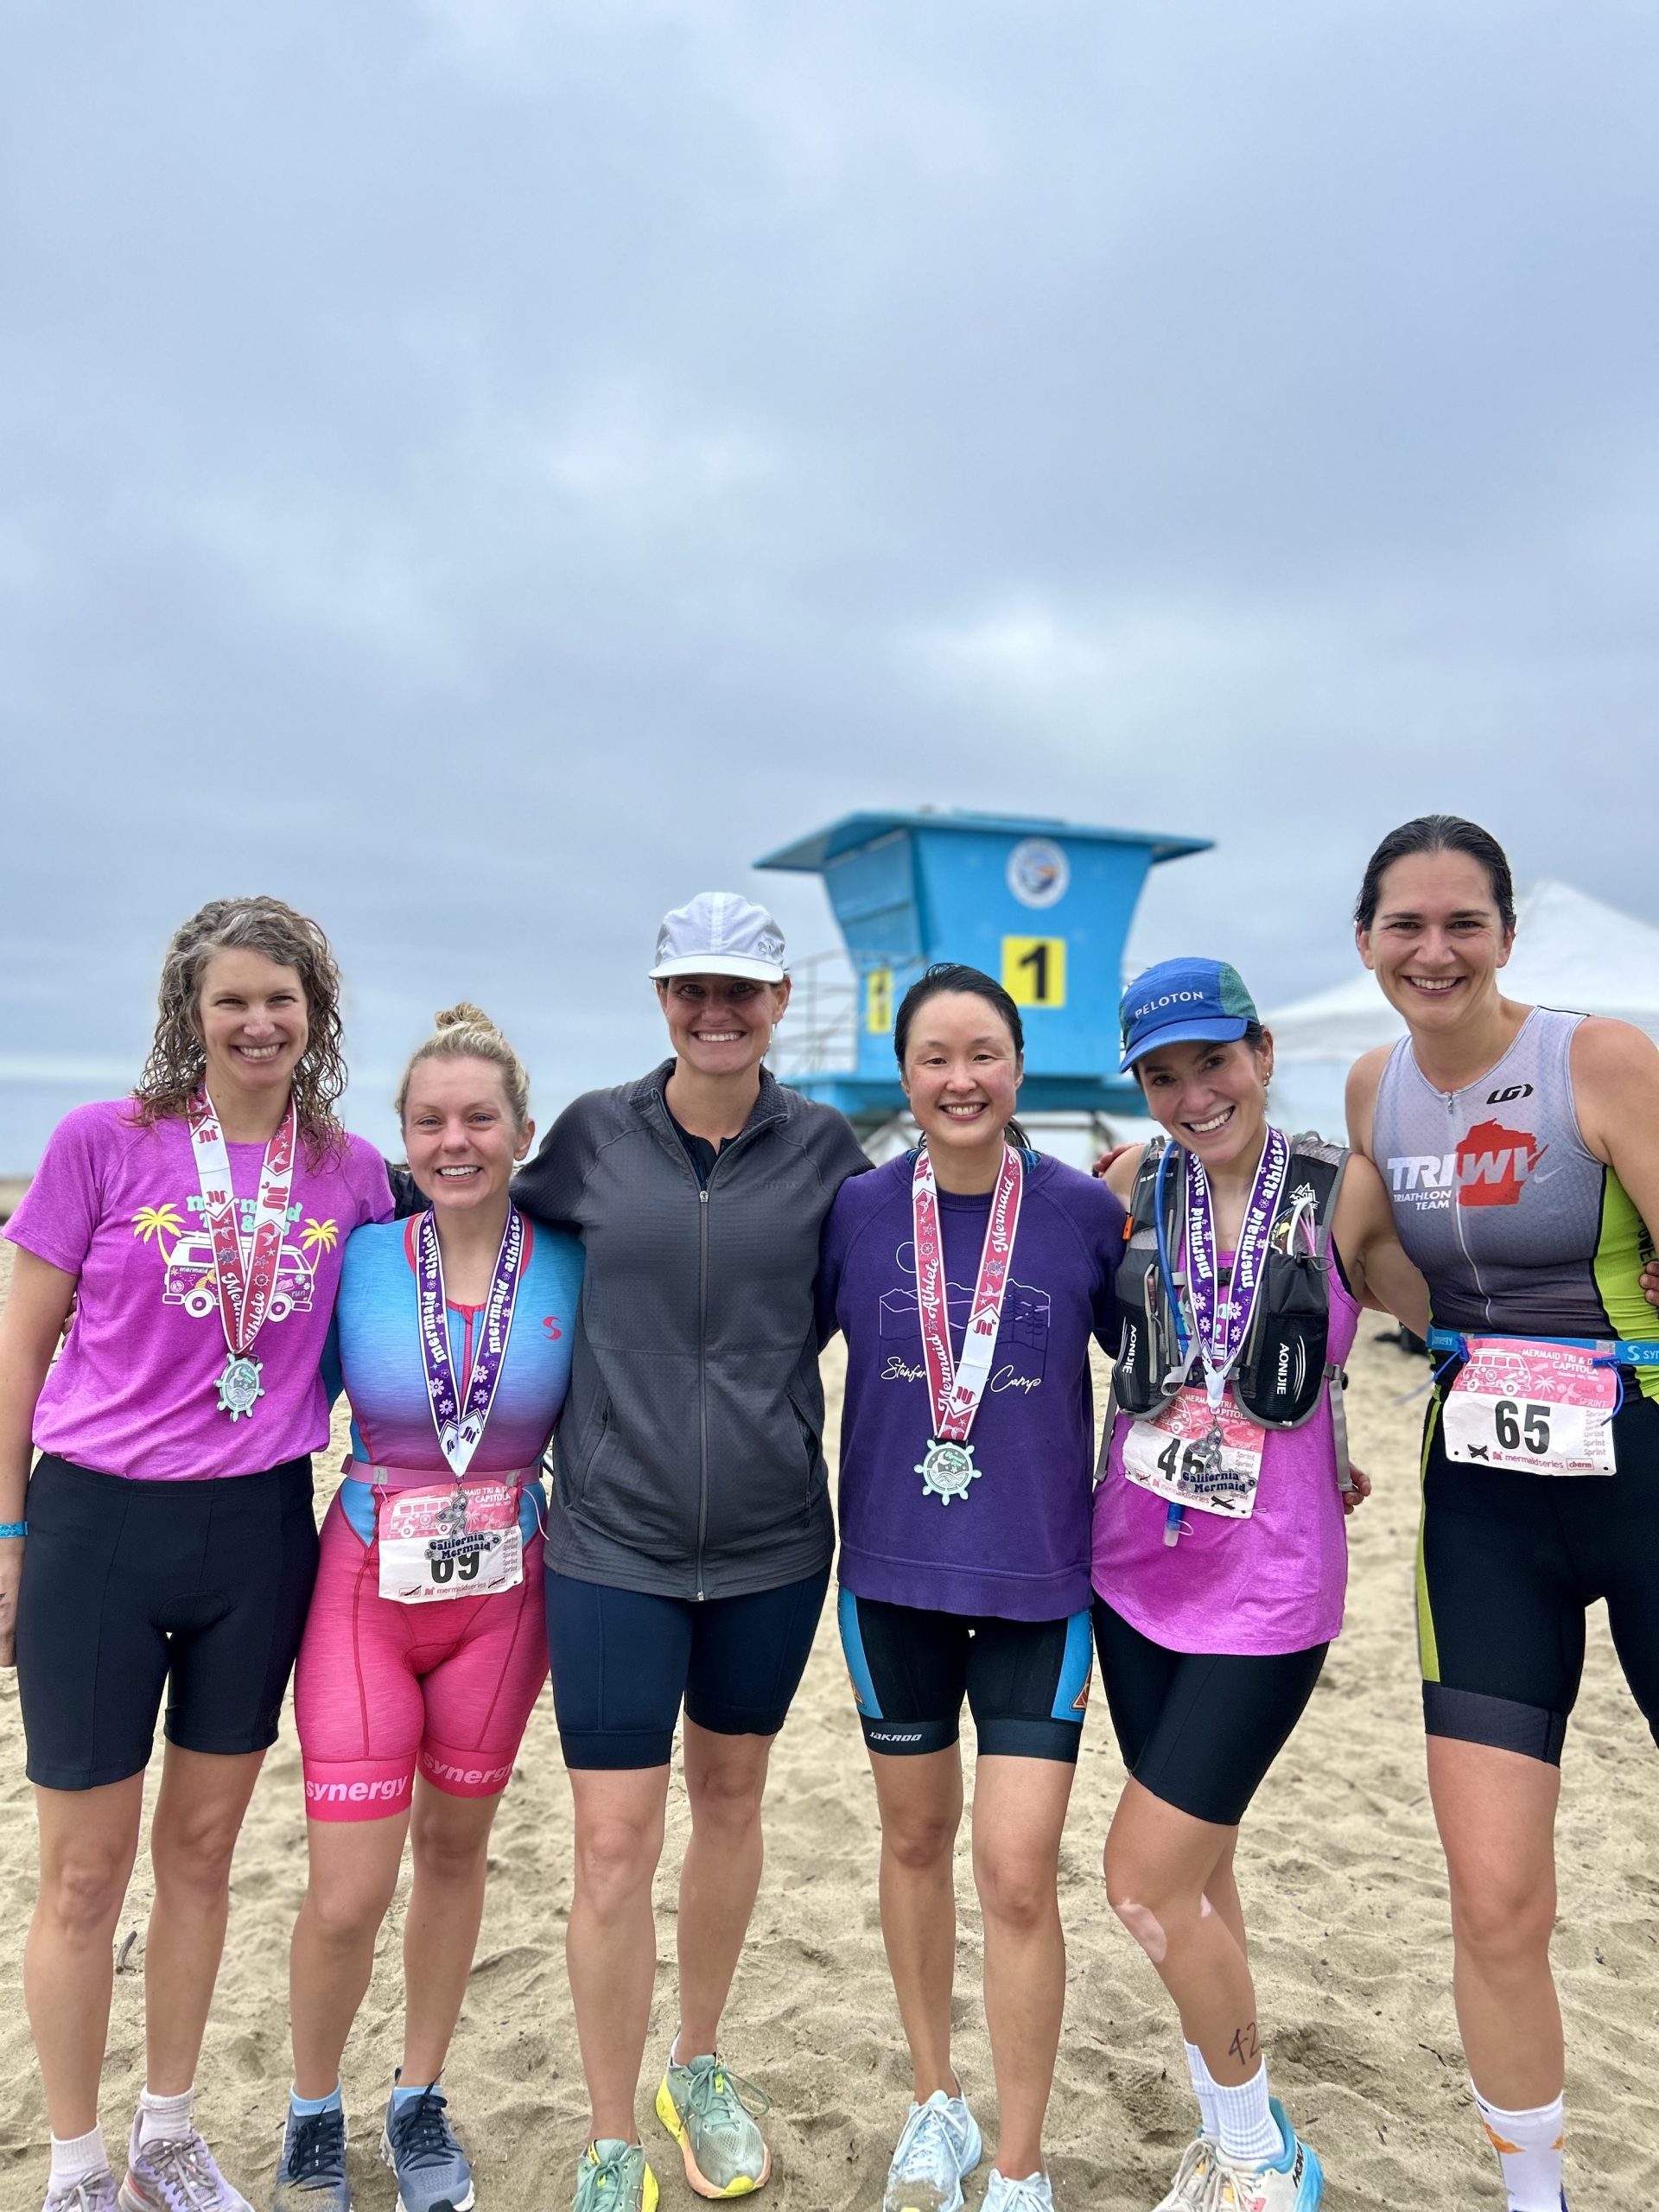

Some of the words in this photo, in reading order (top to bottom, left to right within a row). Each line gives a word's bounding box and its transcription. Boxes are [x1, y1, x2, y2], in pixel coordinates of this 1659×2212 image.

[1020, 943, 1048, 1000] 1
[1135, 991, 1204, 1020] PELOTON
[1394, 1190, 1452, 1203] TRIATHLON
[992, 1175, 1015, 1254] Mermaid
[1241, 1206, 1267, 1288] mermaid
[1262, 1139, 1285, 1200] athlete
[1415, 1201, 1450, 1211] TEAM
[423, 1224, 438, 1280] athlete
[1189, 1207, 1213, 1280] mermaid
[488, 1278, 510, 1354] mermaid
[505, 1215, 521, 1273] athlete
[921, 1256, 940, 1319] Athlete
[421, 1291, 448, 1363] mermaid
[1122, 1324, 1137, 1374] AONIJIE
[1522, 1348, 1561, 1360] MERMAID
[1563, 1354, 1576, 1363] TRI
[880, 1356, 928, 1383] Stanfor
[990, 1364, 1042, 1395] Camp
[1276, 1342, 1289, 1395] AONIJIE
[1553, 1361, 1599, 1376] CAPITOLA
[1185, 1394, 1208, 1404] MERMA
[1221, 1400, 1232, 1408] TRI
[1579, 1397, 1609, 1408] SPRINT
[1211, 1407, 1248, 1420] CAPITOL
[1495, 1400, 1551, 1455] 65
[1236, 1452, 1255, 1460] Sprint
[1584, 1447, 1606, 1456] Sprint
[1505, 1454, 1564, 1469] mermaidseries
[1182, 1471, 1239, 1483] California
[1194, 1482, 1247, 1493] Mermaid
[475, 1494, 512, 1503] CAPITOLA
[429, 1533, 485, 1551] California
[442, 1541, 491, 1560] Mermaid
[869, 1731, 923, 1742] JAKROO
[305, 1775, 409, 1802] synergy
